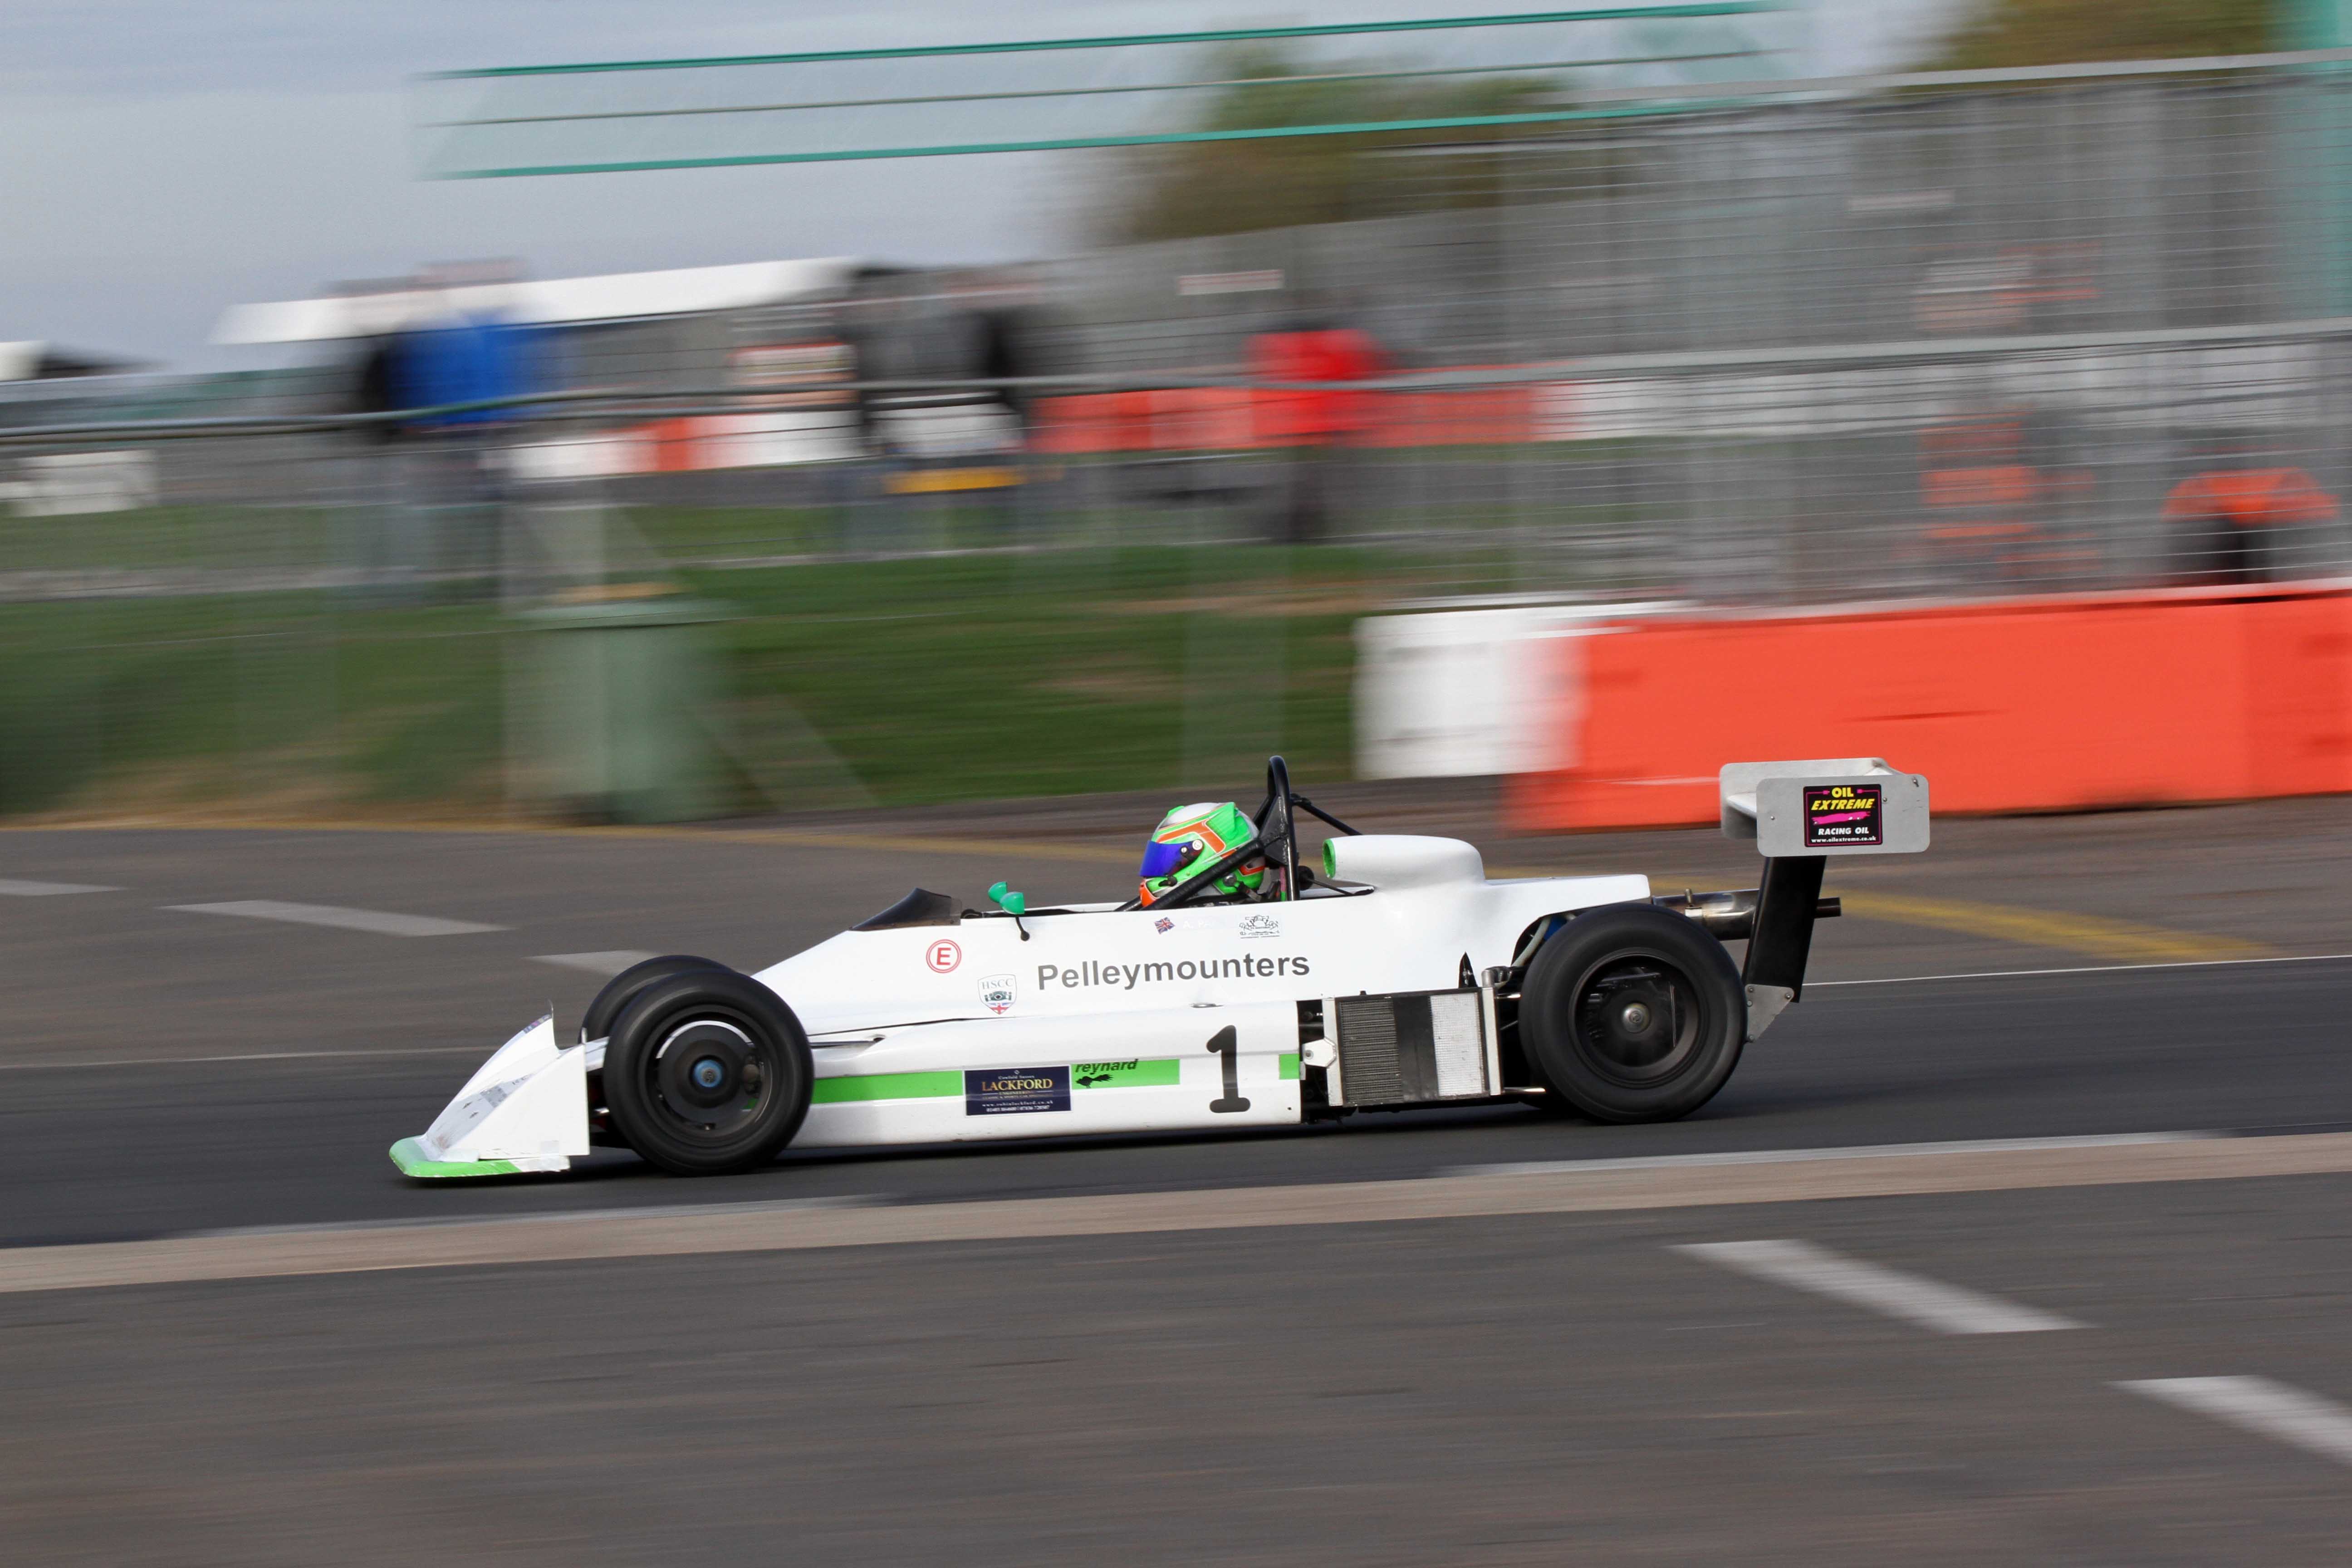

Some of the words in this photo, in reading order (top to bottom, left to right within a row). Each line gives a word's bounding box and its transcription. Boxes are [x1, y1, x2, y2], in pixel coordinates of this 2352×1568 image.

[1832, 787, 1854, 798] OIL
[1811, 799, 1875, 811] EXTREME
[936, 947, 951, 965] E
[1037, 953, 1310, 990] Pelleymounters
[981, 978, 1014, 990] HSCC
[1075, 1058, 1139, 1075] reynard
[1205, 1024, 1251, 1113] 1
[981, 1078, 1054, 1091] LACKFORD
